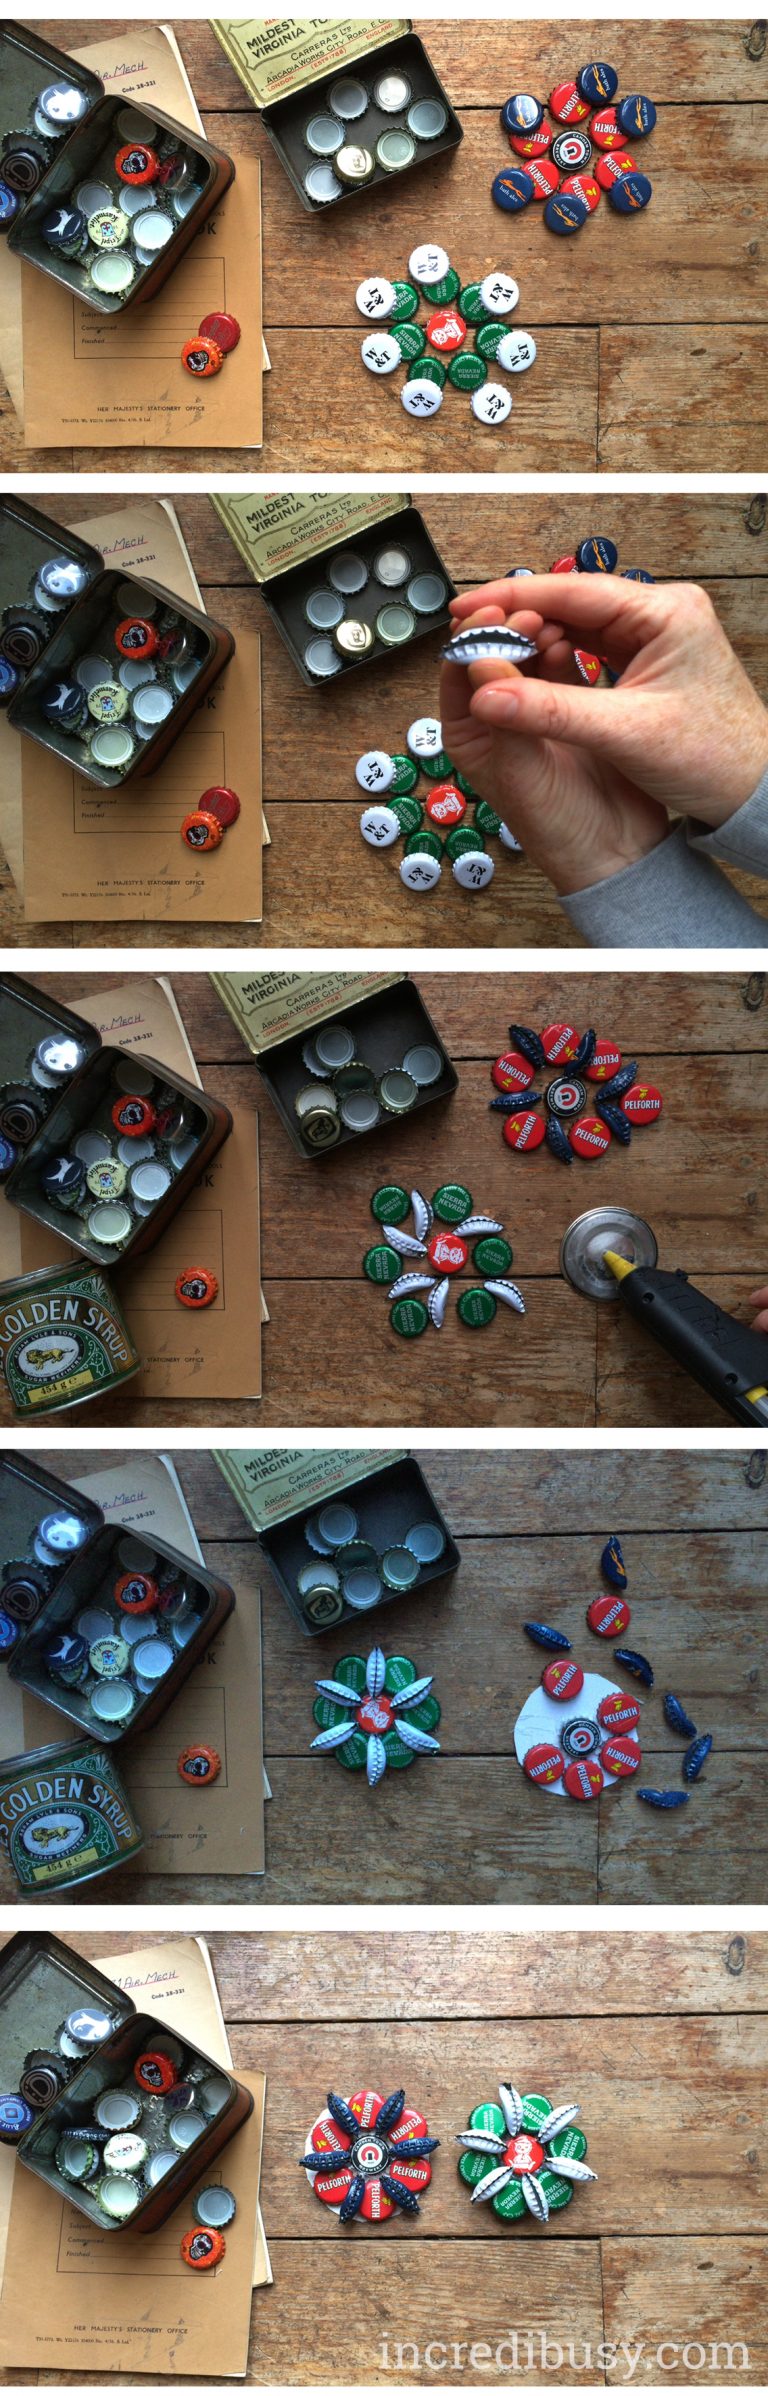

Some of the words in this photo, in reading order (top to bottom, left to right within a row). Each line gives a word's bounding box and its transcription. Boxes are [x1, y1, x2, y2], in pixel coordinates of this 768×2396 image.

[246, 19, 296, 50] MILDEST
[252, 28, 305, 58] VIRGINIA
[366, 23, 393, 40] ENGLAND
[291, 34, 338, 60] CARRERAS
[113, 61, 144, 76] MECH
[267, 64, 299, 83] ARCADIA
[300, 51, 324, 66] WORKS
[326, 40, 344, 51] CITY
[122, 86, 135, 94] Code
[499, 186, 509, 195] bath
[528, 164, 553, 195] PELFORTH
[399, 330, 420, 350] SIERRA
[365, 347, 377, 360] W
[375, 351, 392, 368] &T
[246, 494, 296, 524] MILDEST
[366, 498, 393, 514] ENGLAND
[252, 503, 305, 533] VIRGINIA
[291, 508, 338, 535] CARRERAS
[114, 536, 144, 551] MECH
[267, 539, 299, 558] ARCADIA
[300, 526, 324, 541] WORKS
[326, 515, 344, 526] CITY
[364, 821, 376, 833] W
[374, 823, 390, 841] &T
[247, 973, 301, 1004] VIRGINIA
[286, 980, 334, 1006] CARRERAS
[262, 1010, 294, 1030] ARCADIA
[294, 996, 320, 1012] WORKS
[322, 986, 340, 997] CITY
[111, 1013, 141, 1029] MECH
[547, 1028, 573, 1061] PELFORTH
[499, 1060, 531, 1085] PELFORTH
[624, 1100, 660, 1110] PELFORTH
[516, 1115, 537, 1149] PELFORTH
[575, 1128, 608, 1149] PELFORTH
[439, 1198, 466, 1214] NEVADA
[442, 1192, 467, 1207] SIERRA
[400, 1307, 410, 1332] SIERRA
[406, 1304, 416, 1332] NEVADA
[0, 1300, 79, 1342] GOLDEN
[83, 1307, 128, 1362] SYRUP
[31, 1331, 47, 1341] LYLE
[59, 1330, 76, 1338] SONS
[25, 1374, 47, 1382] SUGAR
[41, 1384, 57, 1395] 454
[250, 1451, 303, 1481] VIRGINIA
[288, 1458, 336, 1484] CARRERAS
[264, 1488, 296, 1506] ARCADIA
[296, 1474, 322, 1490] WORKS
[324, 1464, 342, 1475] CITY
[113, 1491, 143, 1507] MECH
[597, 1600, 624, 1633] PELFORTH
[552, 1664, 578, 1696] PELFORTH
[603, 1706, 638, 1725] PELFORTH
[530, 1754, 561, 1777] PELFORTH
[606, 1746, 639, 1768] PELFORTH
[577, 1764, 593, 1798] PELFORTH
[1, 1778, 84, 1820] GOLDEN
[88, 1785, 132, 1838] SYRUP
[64, 1808, 81, 1816] SONS
[47, 1861, 62, 1872] 454
[145, 1970, 176, 1984] MECH
[361, 2094, 374, 2128] PELFORTH
[391, 2117, 422, 2141] PELFORTH
[317, 2174, 351, 2192] PELFORTH
[393, 2166, 427, 2180] PELFORTH
[371, 2183, 381, 2218] PELFORTH
